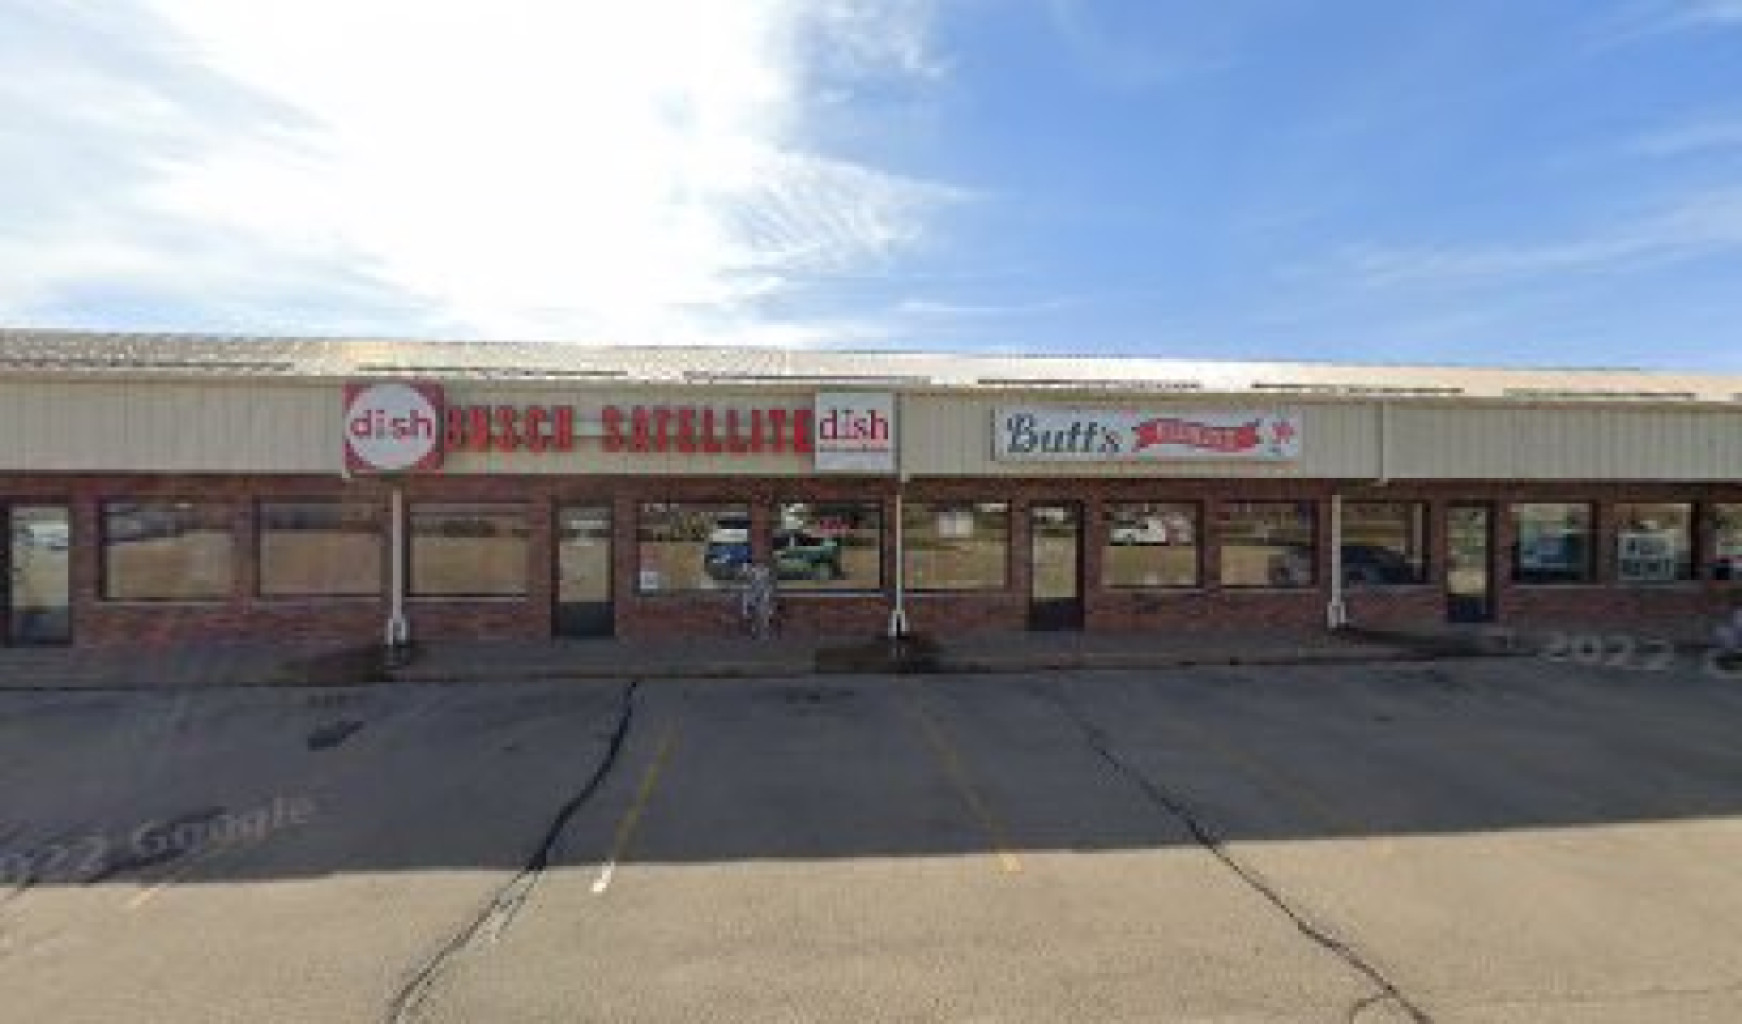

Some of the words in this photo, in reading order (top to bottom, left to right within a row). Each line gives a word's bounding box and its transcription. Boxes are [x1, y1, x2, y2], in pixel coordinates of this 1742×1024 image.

[350, 409, 433, 440] dish
[601, 405, 813, 456] SATELLITE
[819, 408, 889, 440] dish
